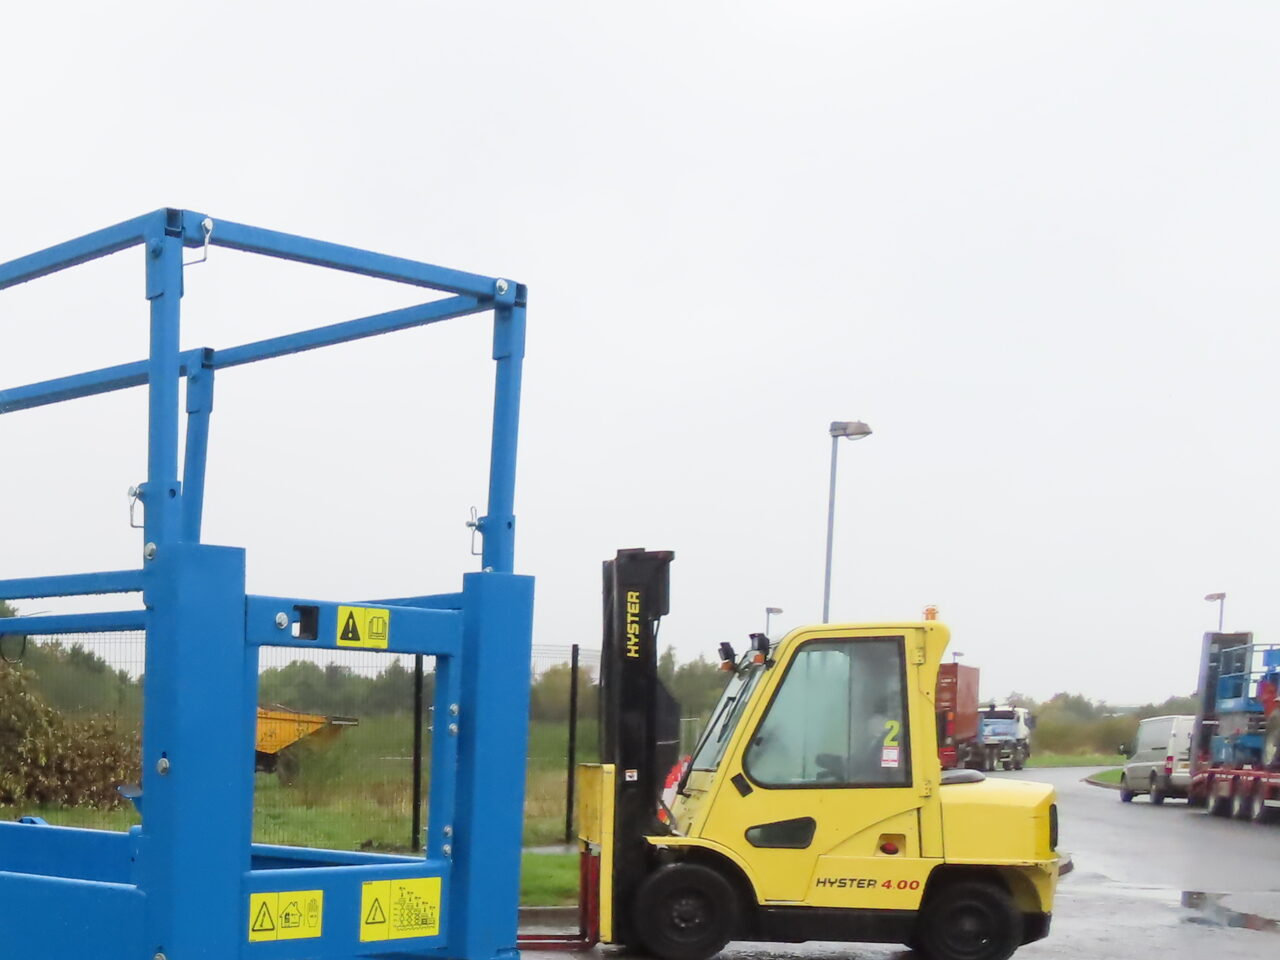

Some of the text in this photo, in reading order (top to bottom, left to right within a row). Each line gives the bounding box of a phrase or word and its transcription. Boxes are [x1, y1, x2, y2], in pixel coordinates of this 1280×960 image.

[626, 591, 640, 658] HYSTER
[883, 720, 900, 746] 2
[815, 878, 878, 889] HYSTER
